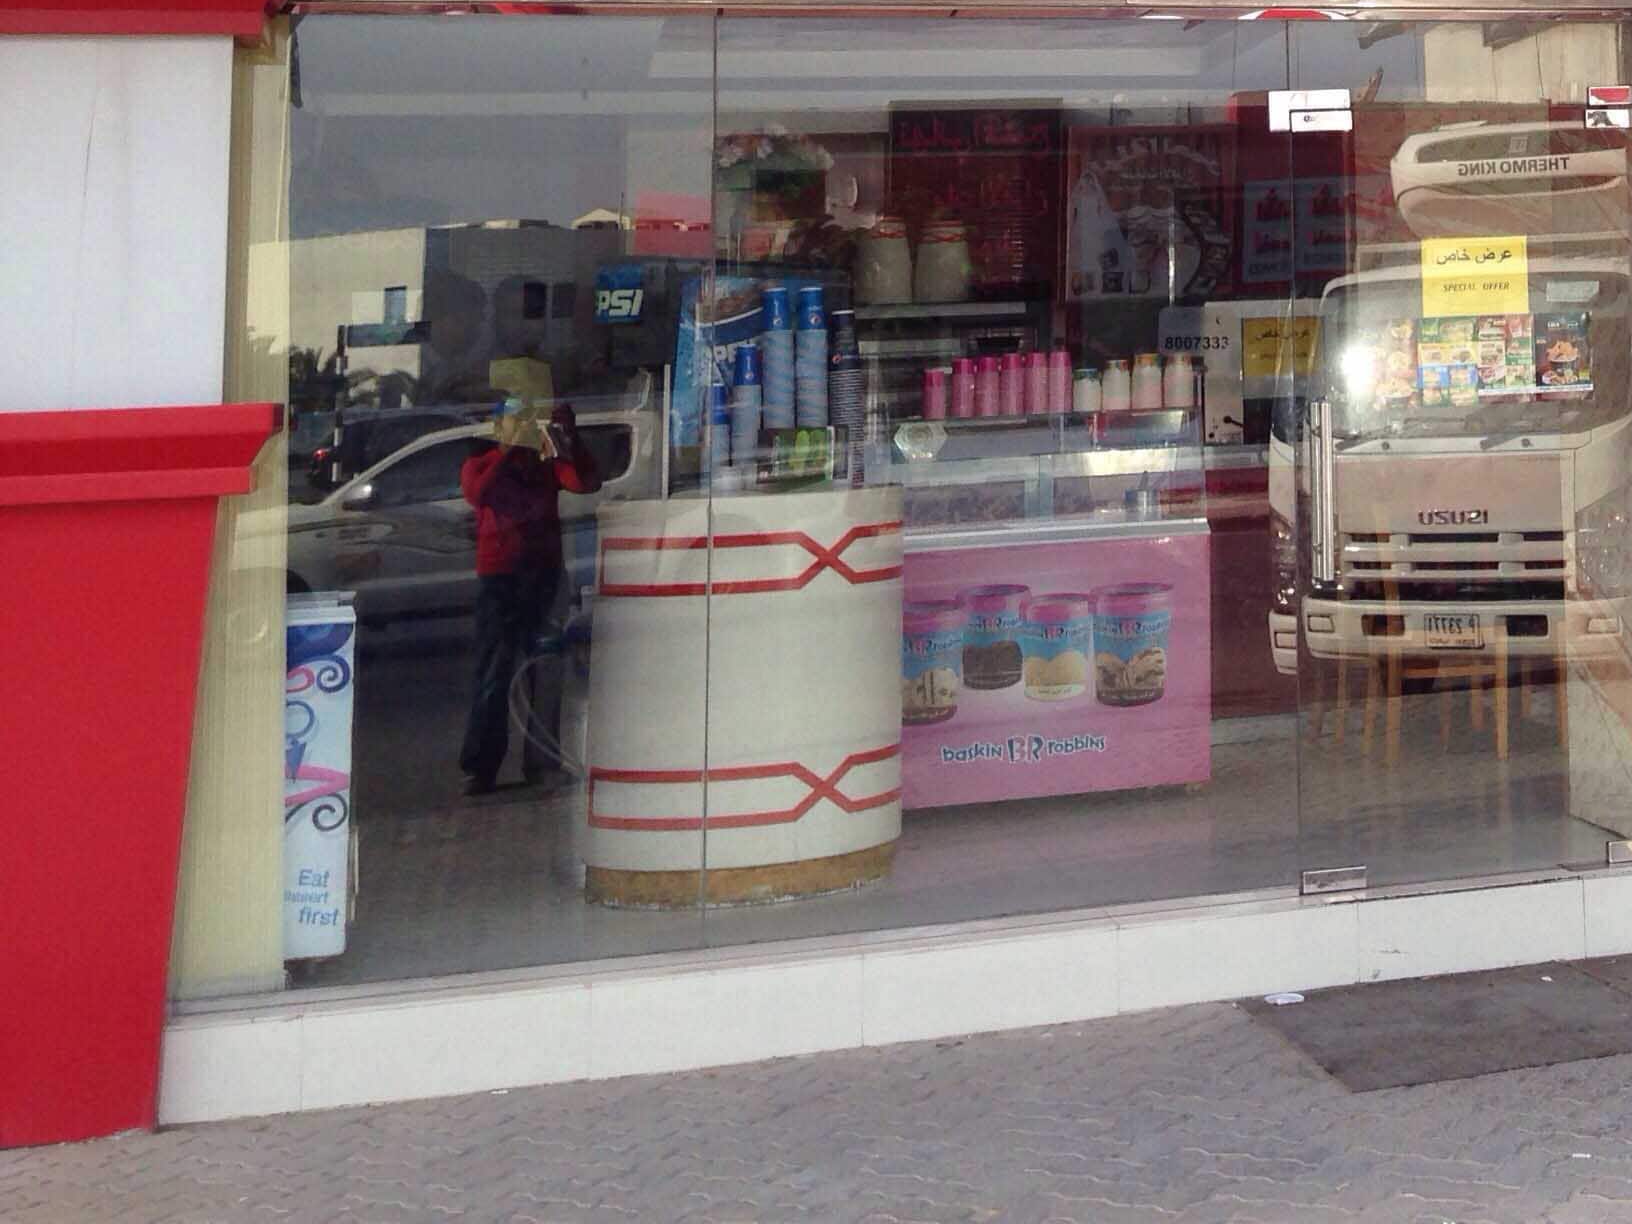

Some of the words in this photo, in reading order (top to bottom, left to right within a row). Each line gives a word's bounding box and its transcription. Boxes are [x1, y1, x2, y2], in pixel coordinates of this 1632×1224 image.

[1164, 335, 1231, 351] 8007333
[299, 869, 329, 887] Eat
[299, 905, 338, 925] first
